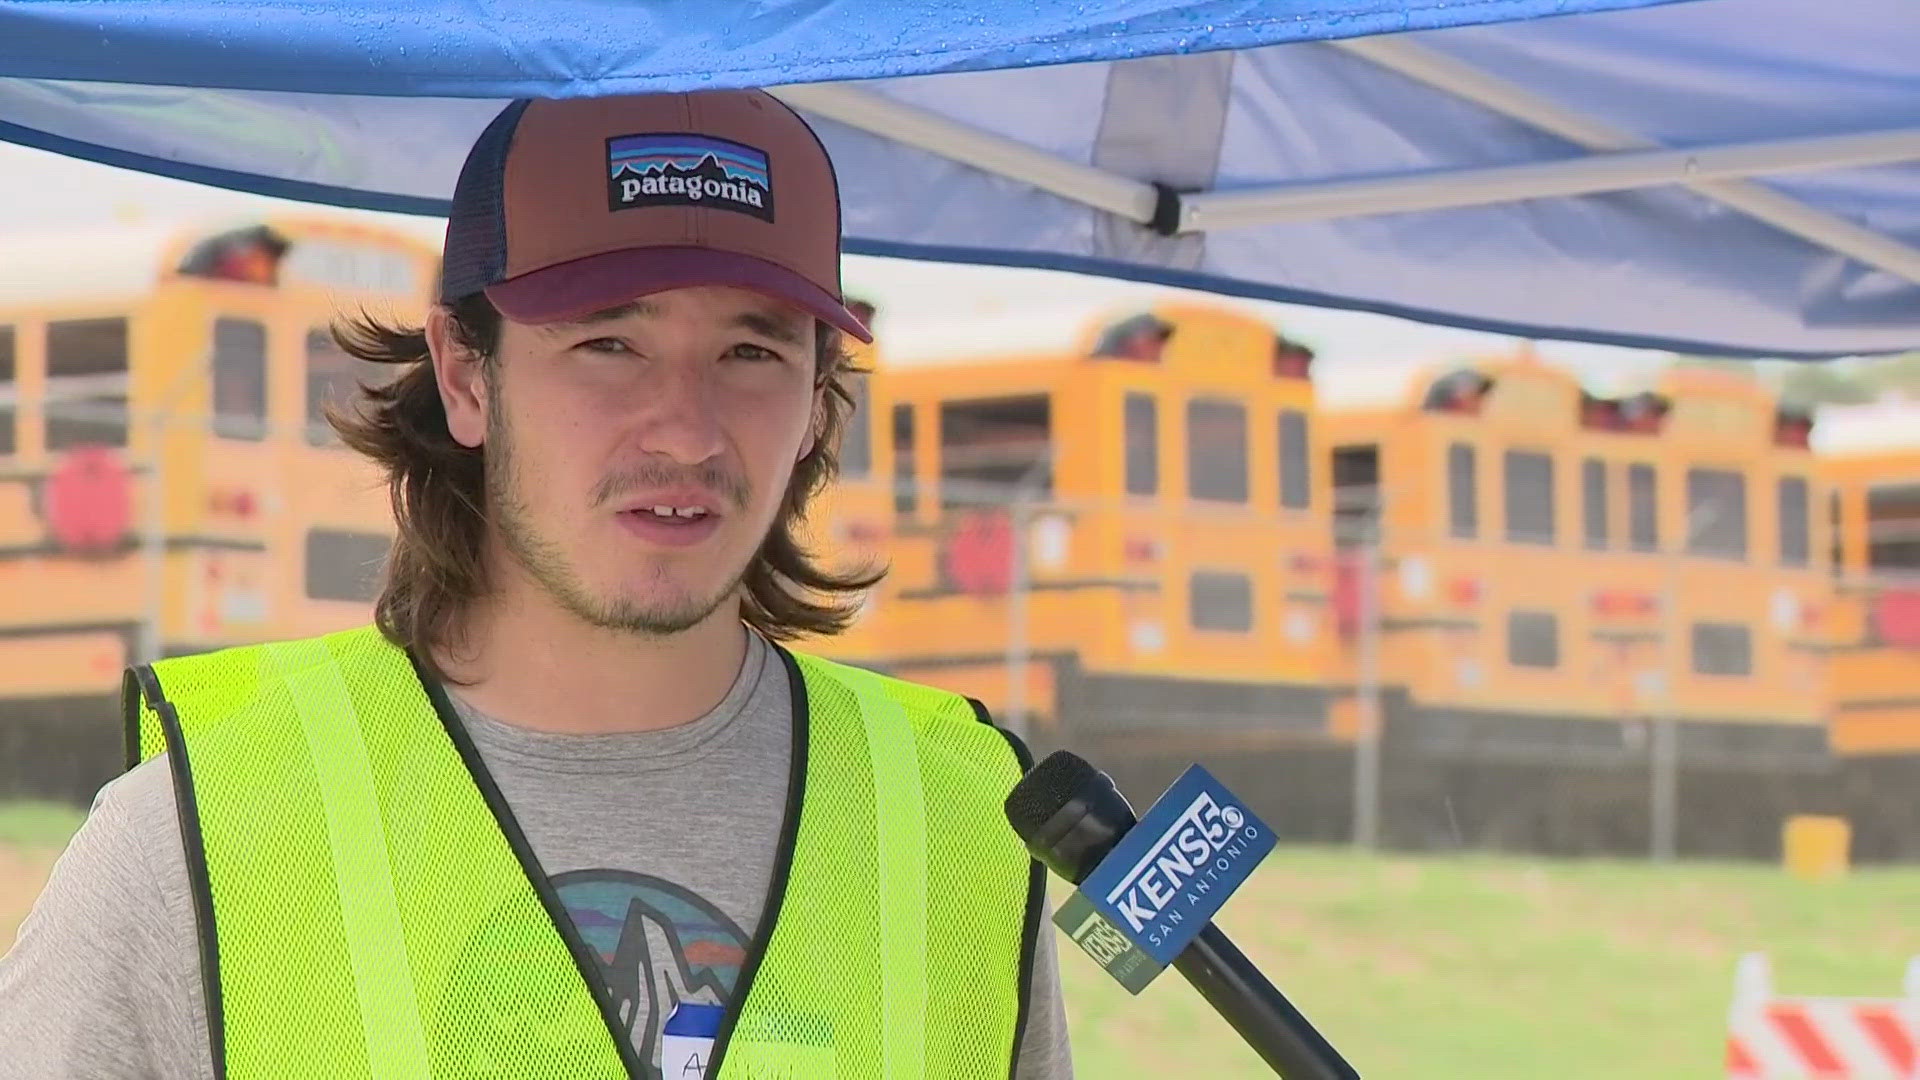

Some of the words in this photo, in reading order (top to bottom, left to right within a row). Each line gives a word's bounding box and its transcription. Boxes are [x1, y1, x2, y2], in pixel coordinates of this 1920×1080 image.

[621, 174, 764, 209] patagonia
[1150, 911, 1183, 947] SAN
[1186, 825, 1258, 906] ANTONIO
